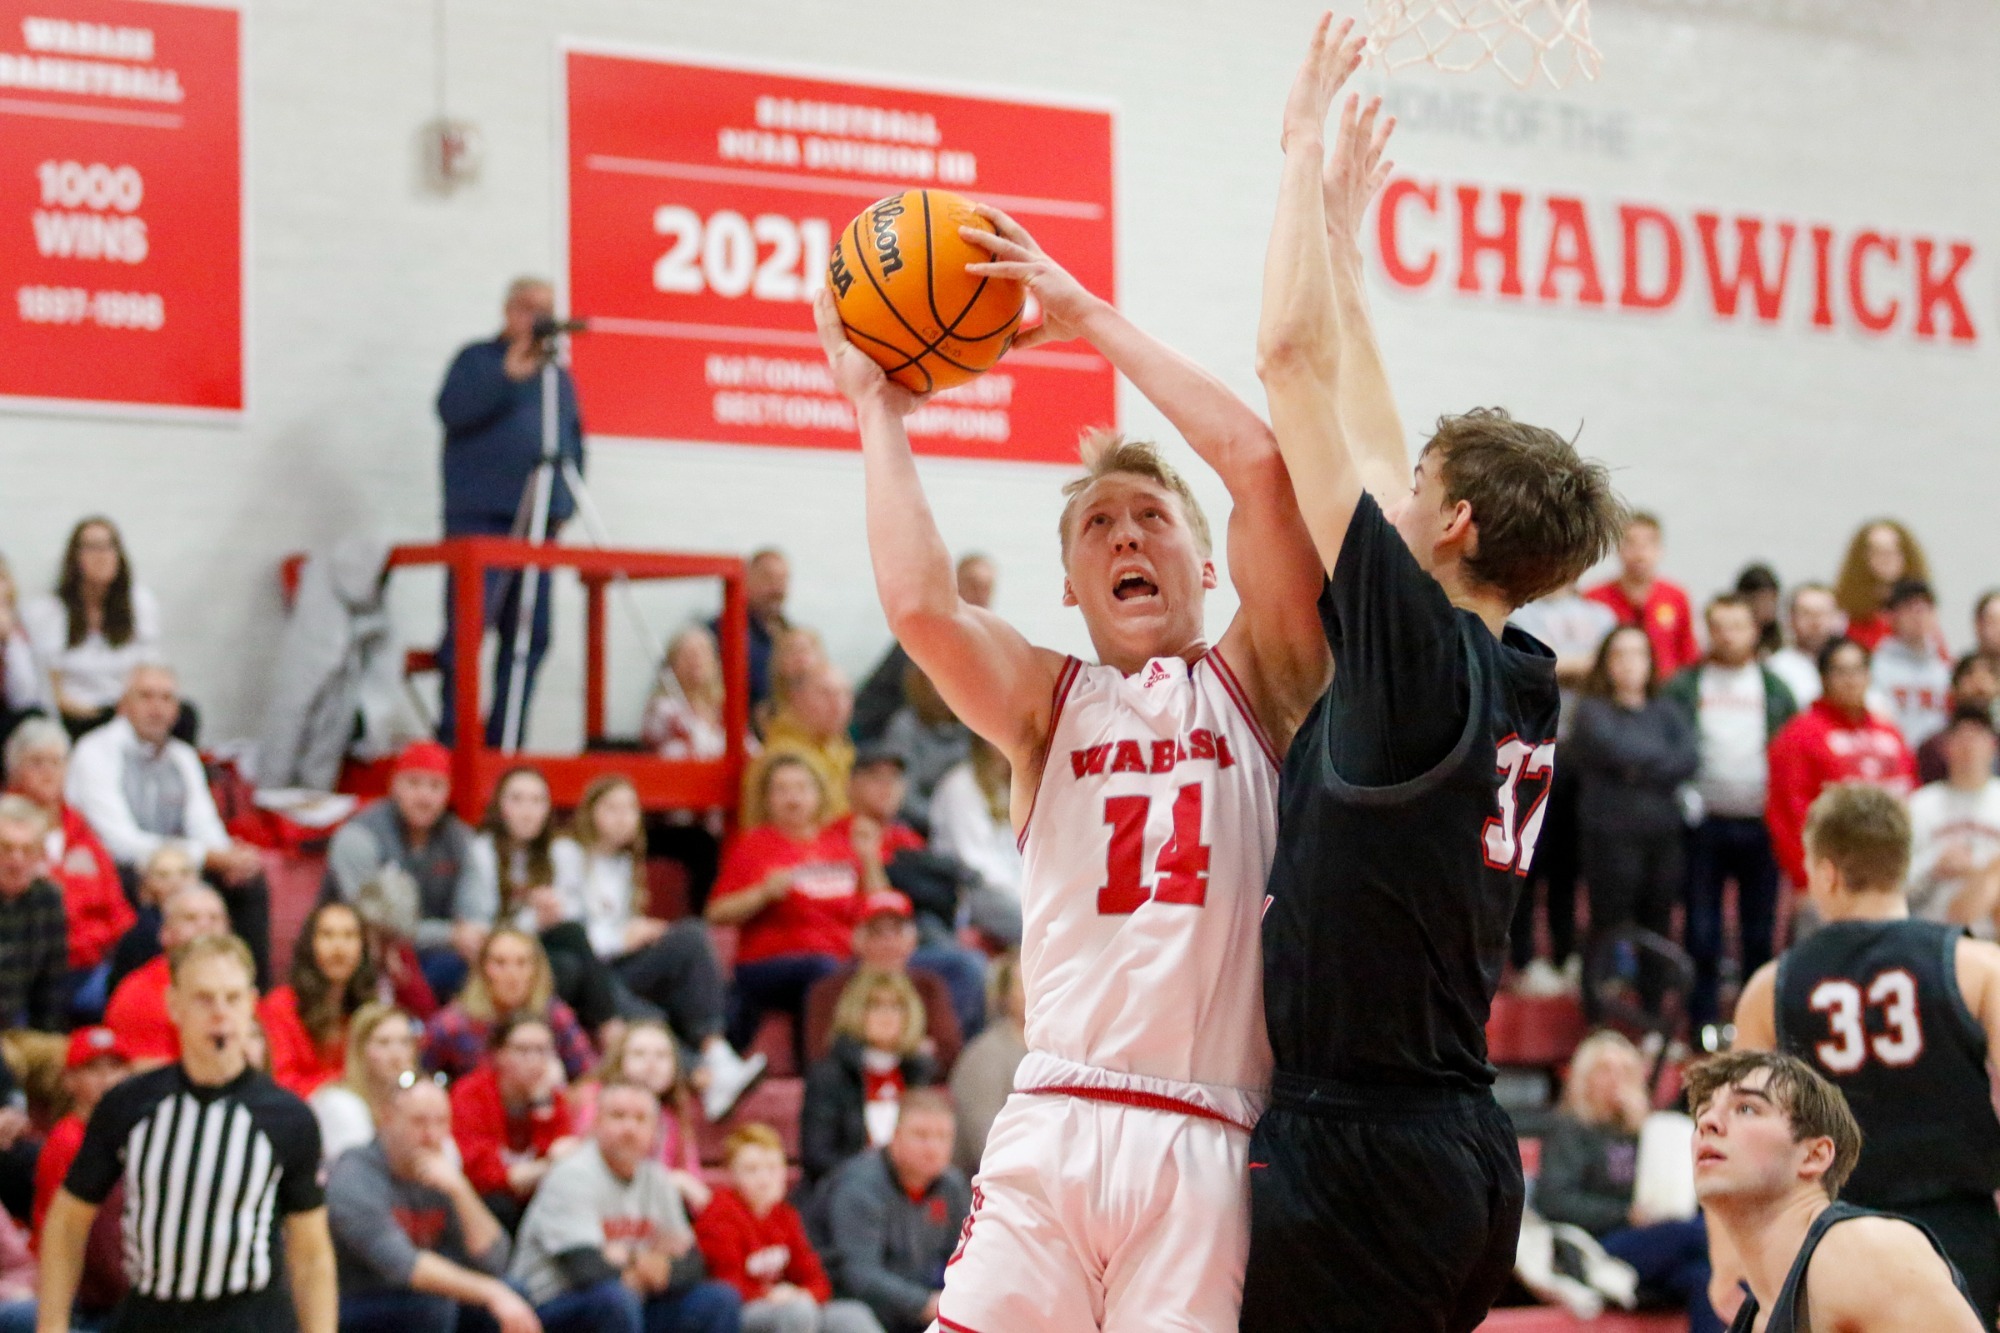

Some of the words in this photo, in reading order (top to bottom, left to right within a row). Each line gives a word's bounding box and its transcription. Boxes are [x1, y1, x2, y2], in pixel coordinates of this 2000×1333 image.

[37, 160, 144, 213] 1000
[32, 209, 149, 265] WINS
[652, 204, 831, 304] 2021
[829, 239, 855, 299] CAA
[873, 191, 905, 280] ilson
[1375, 176, 1978, 343] CHADWICK
[902, 405, 1010, 442] AMPIONS
[1143, 672, 1171, 689] addas
[1096, 780, 1212, 916] 14
[1481, 731, 1557, 879] 32
[1808, 966, 1925, 1074] 33
